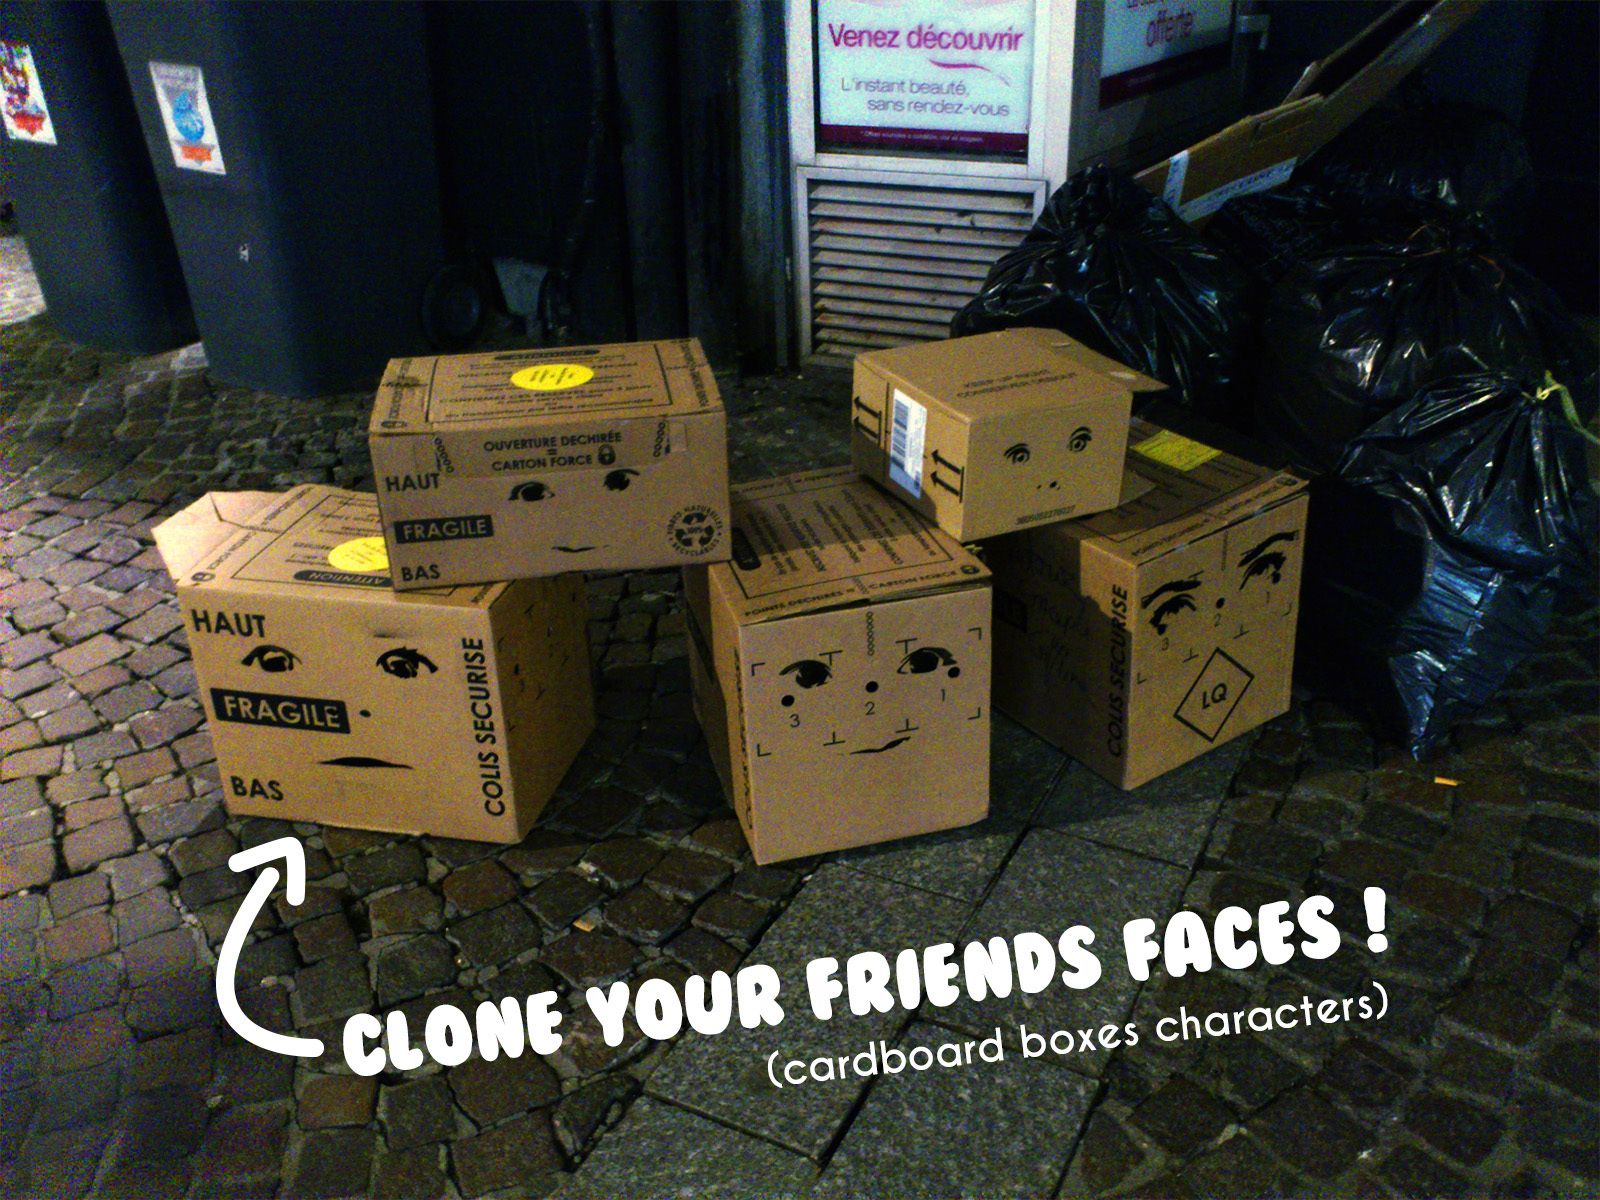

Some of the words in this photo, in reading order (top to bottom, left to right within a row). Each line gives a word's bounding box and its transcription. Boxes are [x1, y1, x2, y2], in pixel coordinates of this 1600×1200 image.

[827, 23, 899, 49] Venez
[906, 23, 1024, 52] découvrir
[841, 77, 905, 93] L'instant
[909, 79, 970, 97] beauté,
[867, 98, 905, 112] sans
[907, 100, 1010, 117] rendez-vous
[483, 436, 558, 453] OUVERTURE
[560, 430, 623, 446] DECHIRÉE
[491, 458, 547, 472] CARTON
[550, 454, 593, 467] FORCE
[385, 472, 441, 493] HAUT
[403, 518, 488, 540] FRAGILE
[401, 563, 441, 582] BAS
[191, 608, 266, 638] HAUT
[1214, 613, 1223, 629] 2
[1110, 583, 1128, 689] SECURISE
[461, 636, 497, 746] SECURISE
[1201, 682, 1228, 711] LQ
[222, 694, 342, 730] FRAGILE
[789, 713, 801, 729] 3
[864, 700, 876, 716] 2
[940, 687, 947, 703] 1
[1107, 693, 1124, 758] COLIS
[230, 775, 284, 802] BAS
[476, 750, 507, 817] COLIS
